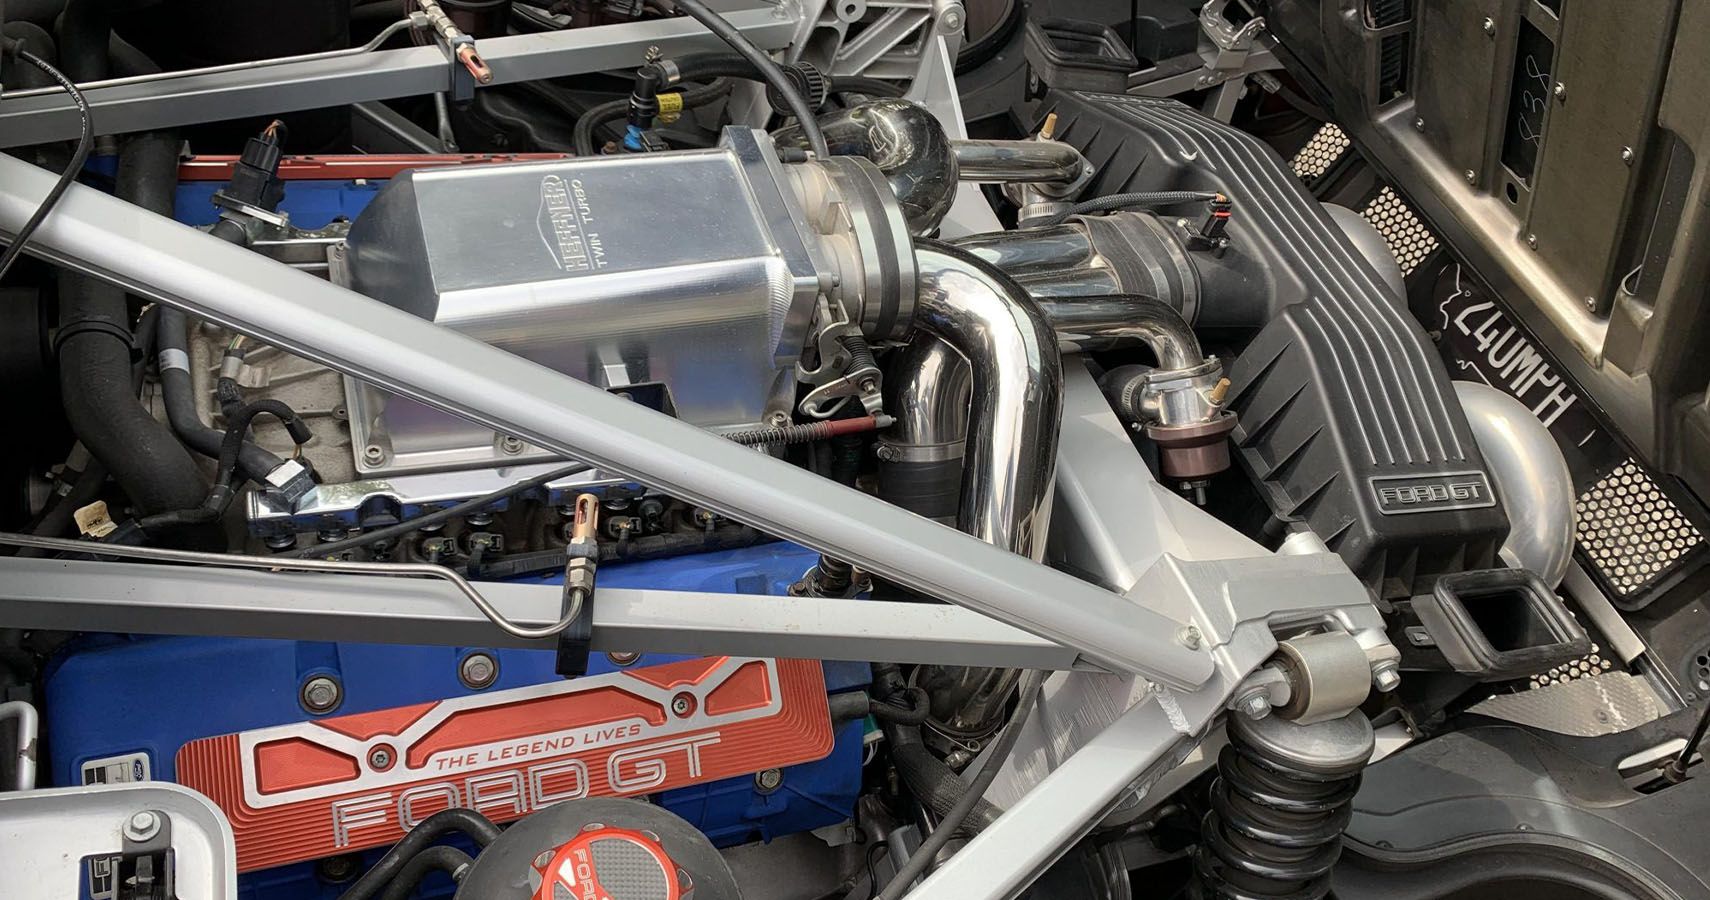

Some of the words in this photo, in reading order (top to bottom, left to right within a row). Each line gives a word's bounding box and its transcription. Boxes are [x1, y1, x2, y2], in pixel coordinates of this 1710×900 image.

[572, 179, 594, 224] TURBO
[543, 182, 590, 272] HEFFNER
[587, 232, 609, 268] TWIN
[1380, 485, 1449, 505] FORD
[1448, 481, 1481, 499] GT
[436, 752, 479, 770] THE
[487, 736, 575, 762] LEGEND
[583, 724, 641, 744] LIVES
[332, 758, 590, 848] FORD
[606, 731, 721, 793] GT
[573, 848, 597, 900] FOR
